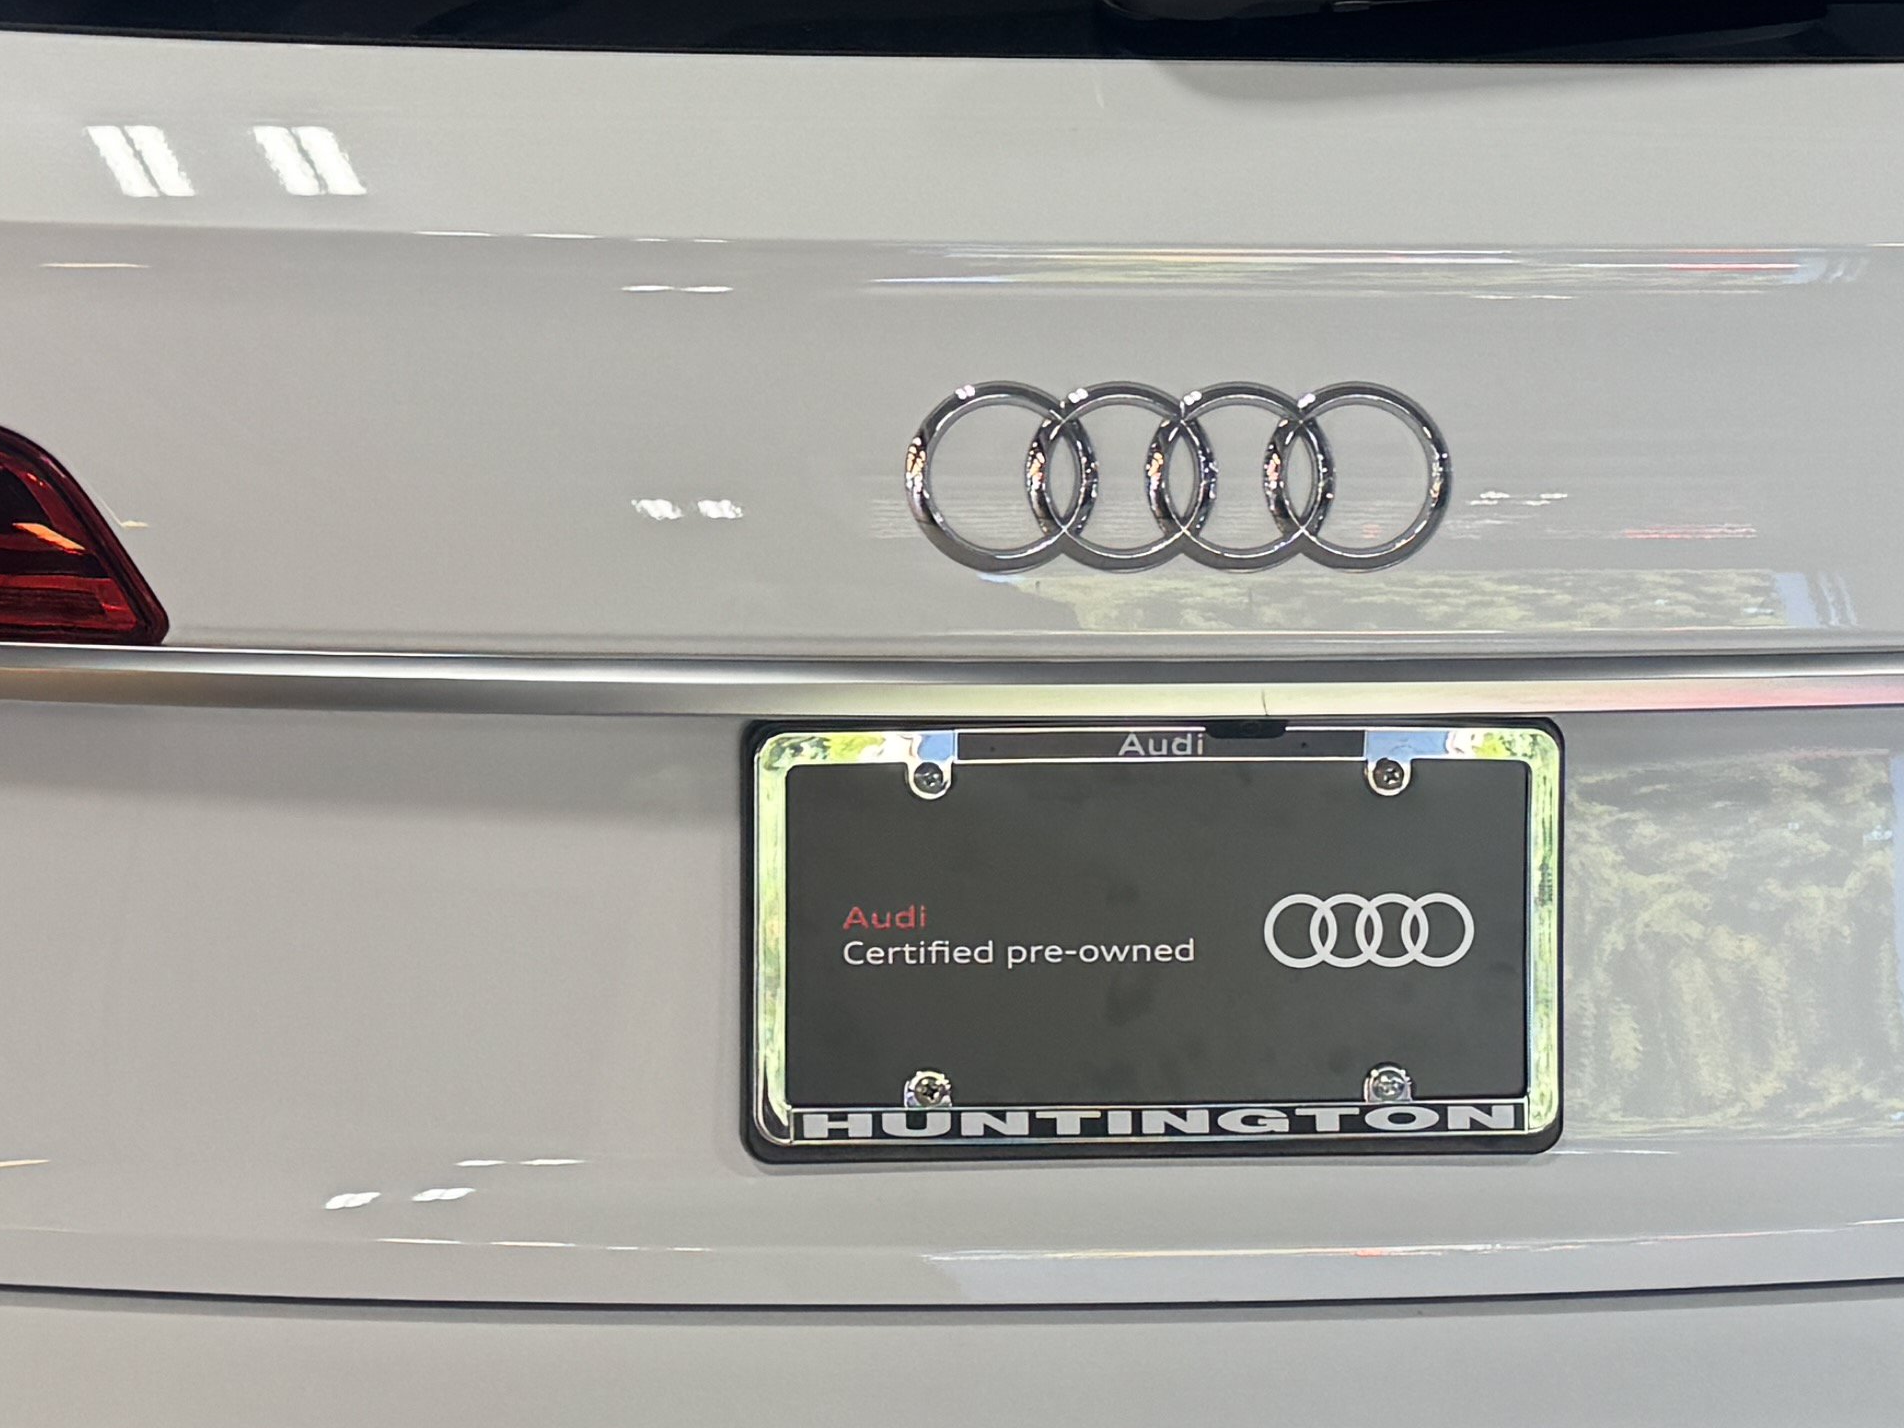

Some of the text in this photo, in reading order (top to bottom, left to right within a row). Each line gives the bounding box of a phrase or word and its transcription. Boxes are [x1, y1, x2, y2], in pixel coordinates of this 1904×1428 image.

[1117, 732, 1204, 757] Audi
[843, 905, 928, 930] Audi
[843, 937, 1196, 970] Certified pre-owned
[801, 1104, 1516, 1139] HUNTINGTON
